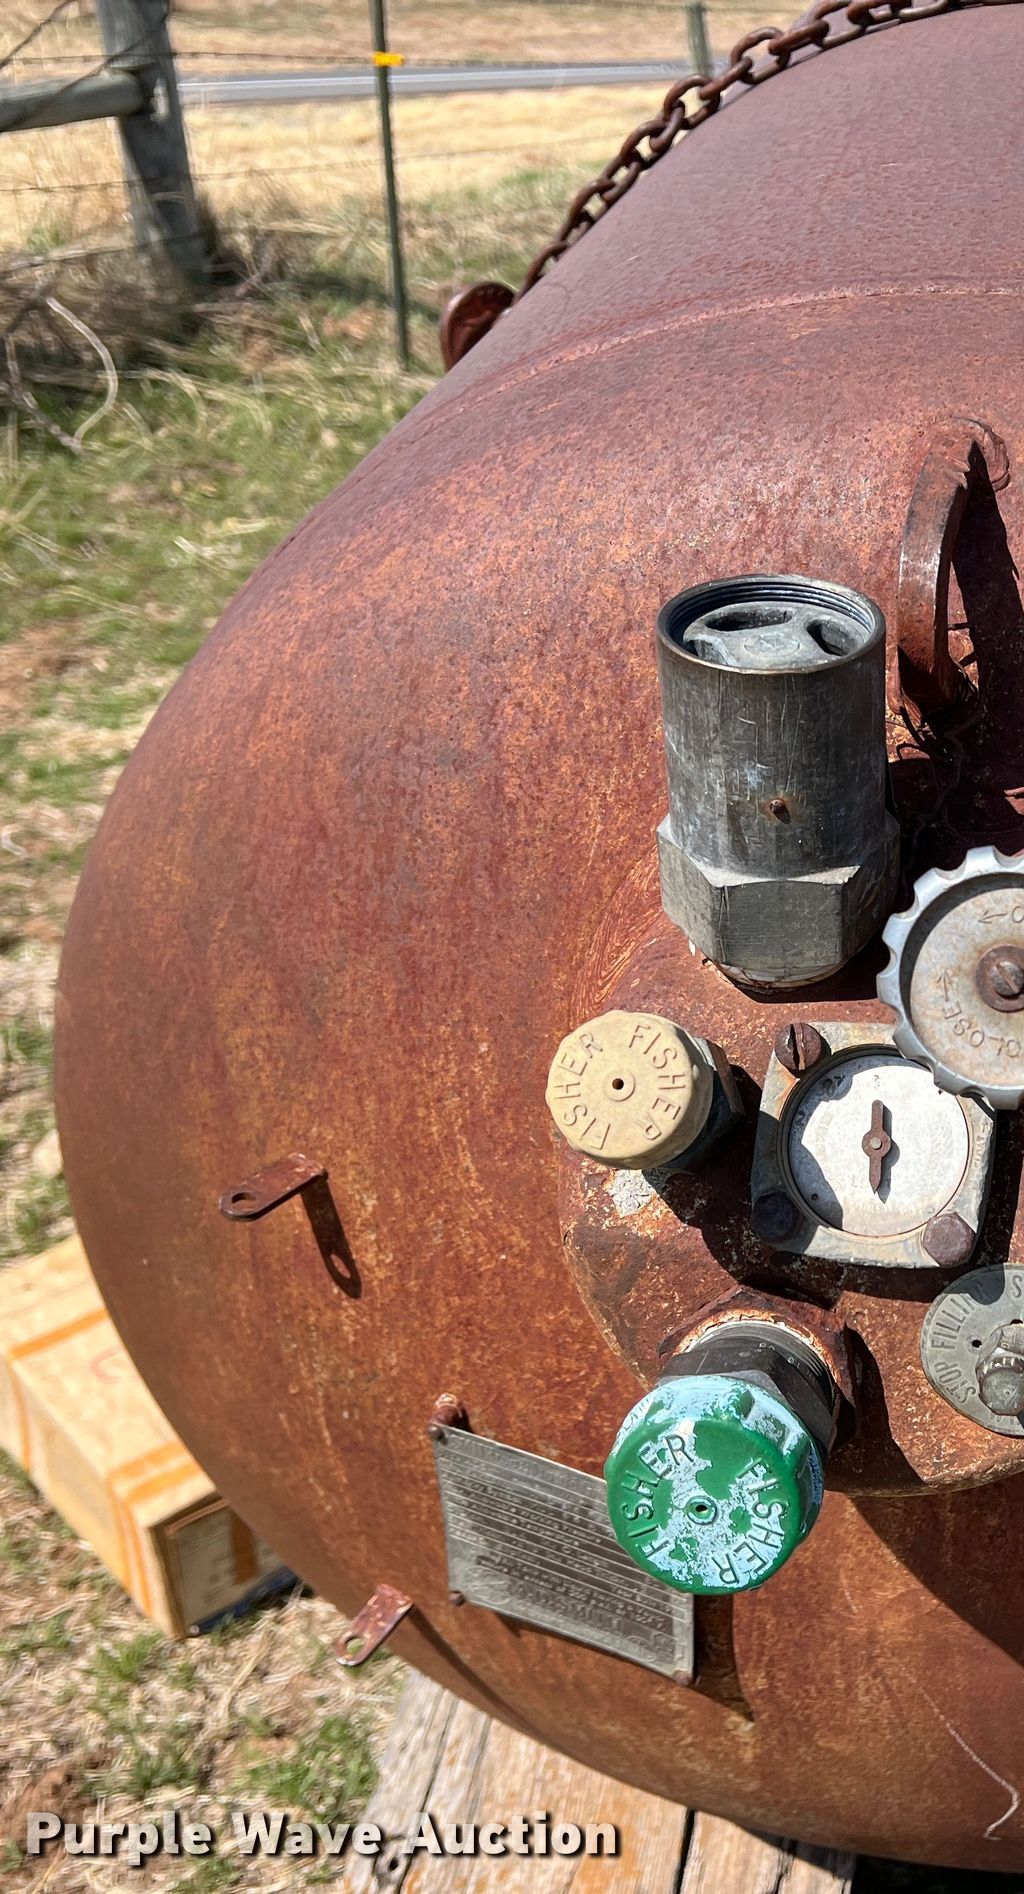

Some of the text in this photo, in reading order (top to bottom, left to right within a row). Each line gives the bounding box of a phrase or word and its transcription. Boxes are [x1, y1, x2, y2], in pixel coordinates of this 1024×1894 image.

[628, 1024, 686, 1141] FISHER
[942, 1001, 1022, 1059] CLOSE
[553, 1032, 612, 1150] FISHER
[934, 1361, 977, 1404] STOP
[620, 1433, 694, 1558] FISHER
[711, 1457, 789, 1584] FISHER
